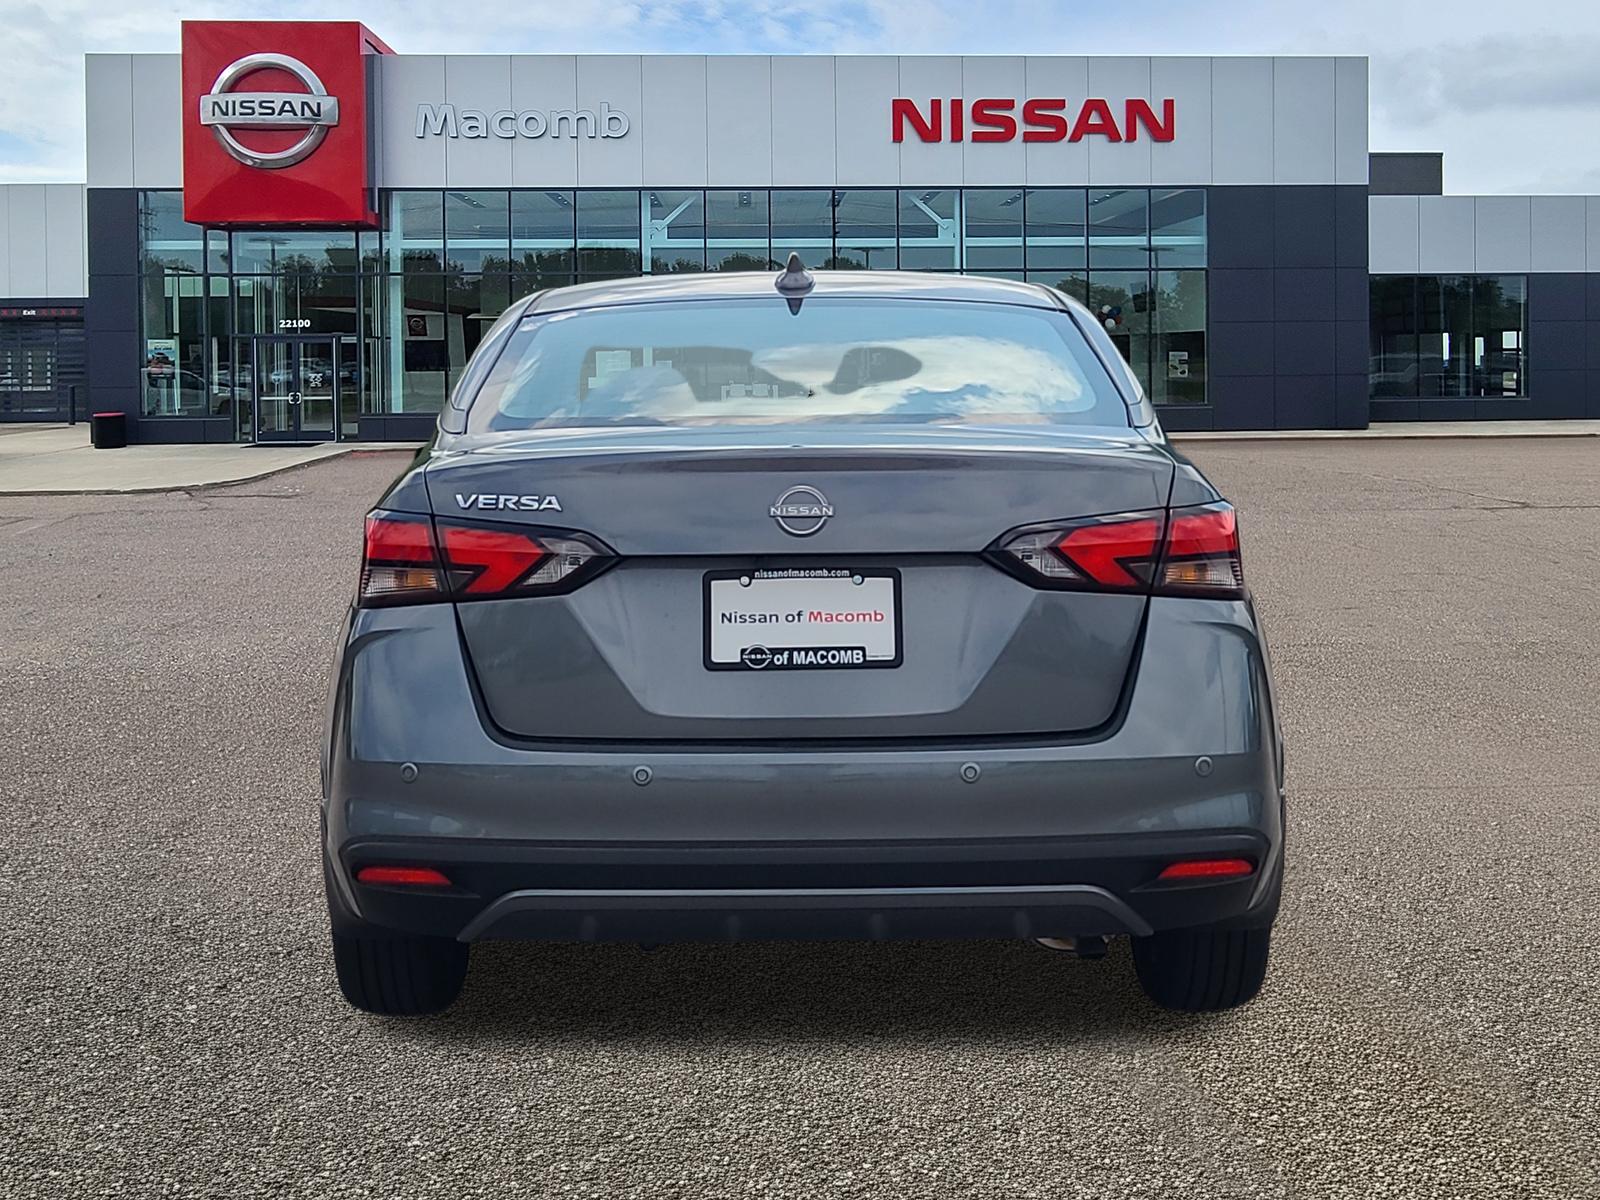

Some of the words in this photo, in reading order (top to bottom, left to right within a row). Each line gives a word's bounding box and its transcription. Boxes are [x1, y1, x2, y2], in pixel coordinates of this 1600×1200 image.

[212, 100, 322, 118] NISSAN
[415, 102, 630, 138] Macomb
[892, 98, 1175, 142] NISSAN
[279, 319, 311, 328] 22100
[455, 494, 562, 512] VERSA
[770, 506, 833, 516] NISSAN
[754, 569, 850, 578] nissanofmacomb.com
[721, 611, 779, 624] Nissan
[785, 611, 804, 623] of
[808, 610, 885, 623] Macomb
[774, 652, 790, 665] of
[793, 650, 864, 665] MACOMB
